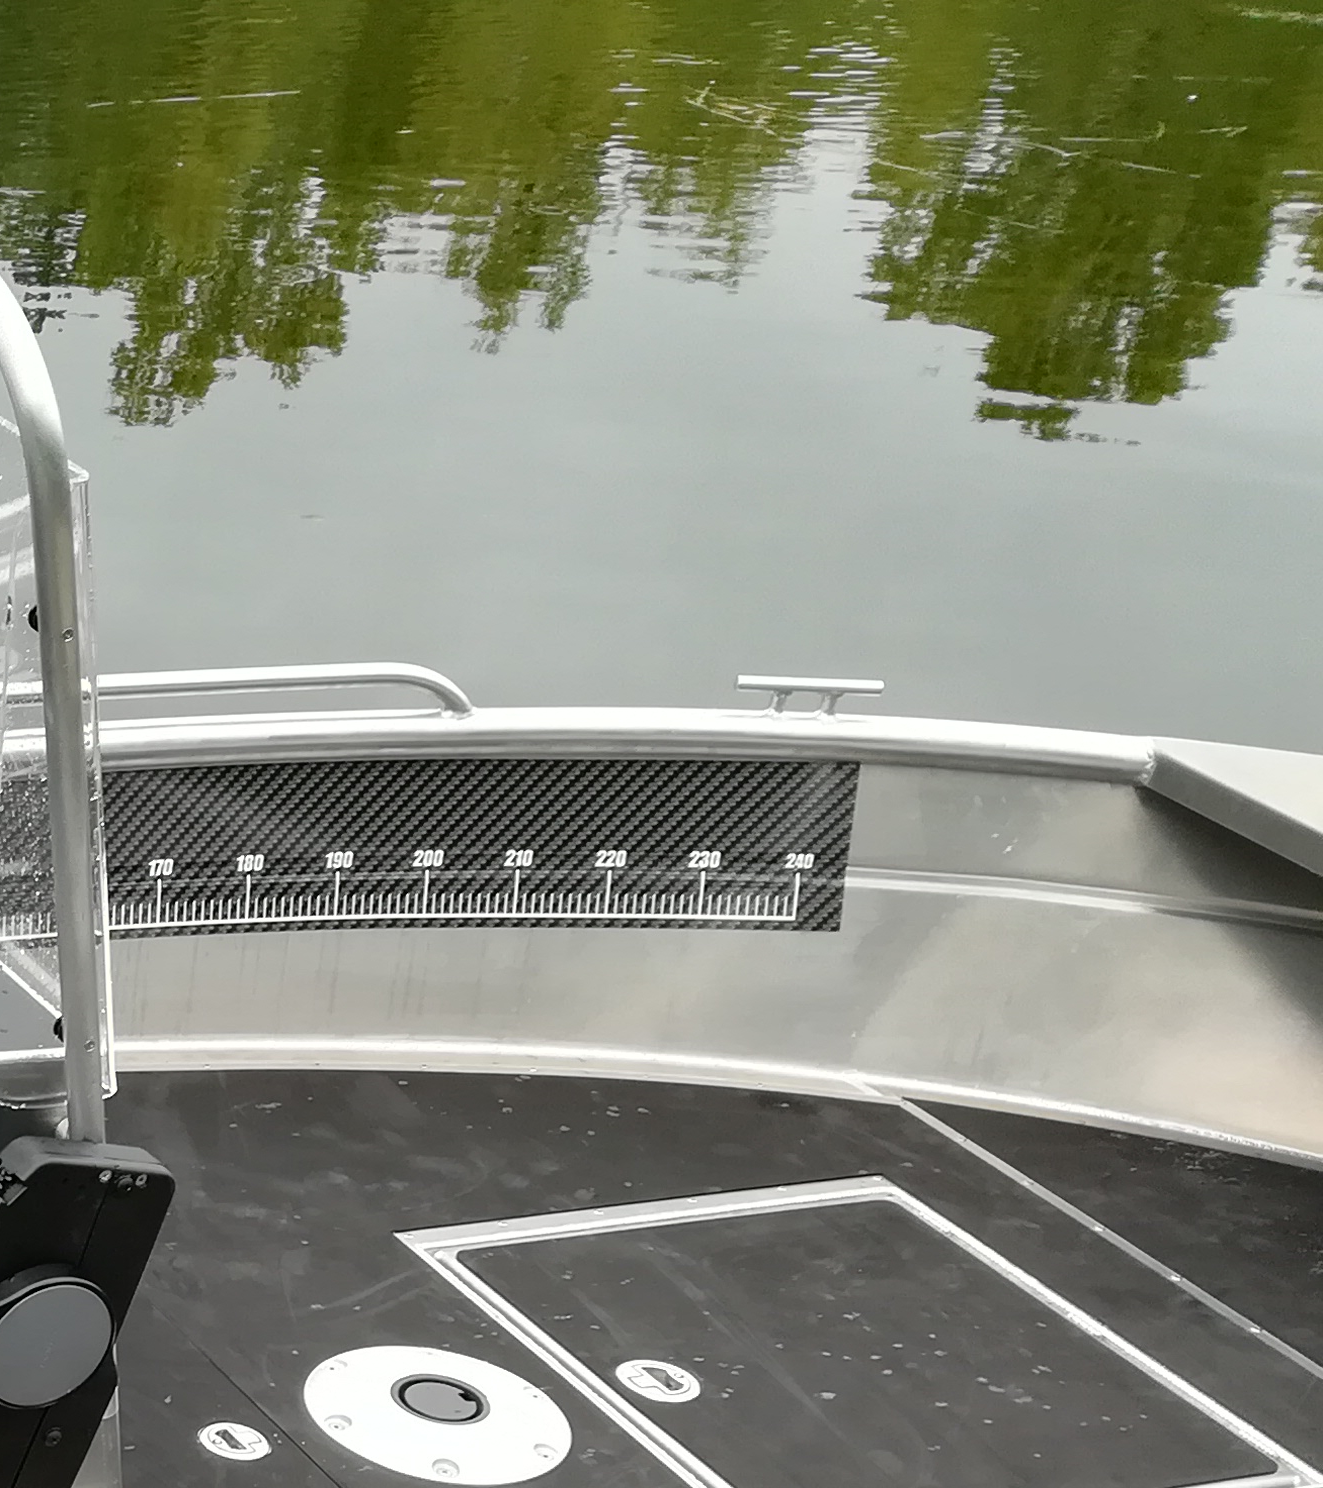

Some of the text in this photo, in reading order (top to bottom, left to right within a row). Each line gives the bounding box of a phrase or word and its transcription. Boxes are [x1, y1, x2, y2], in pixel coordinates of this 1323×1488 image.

[148, 859, 173, 876] 170
[237, 854, 264, 872] 180
[325, 851, 353, 869] 190
[412, 850, 444, 867] 200
[504, 849, 533, 867] 210
[595, 850, 627, 867] 220
[688, 851, 721, 868] 230
[785, 853, 814, 869] 240
